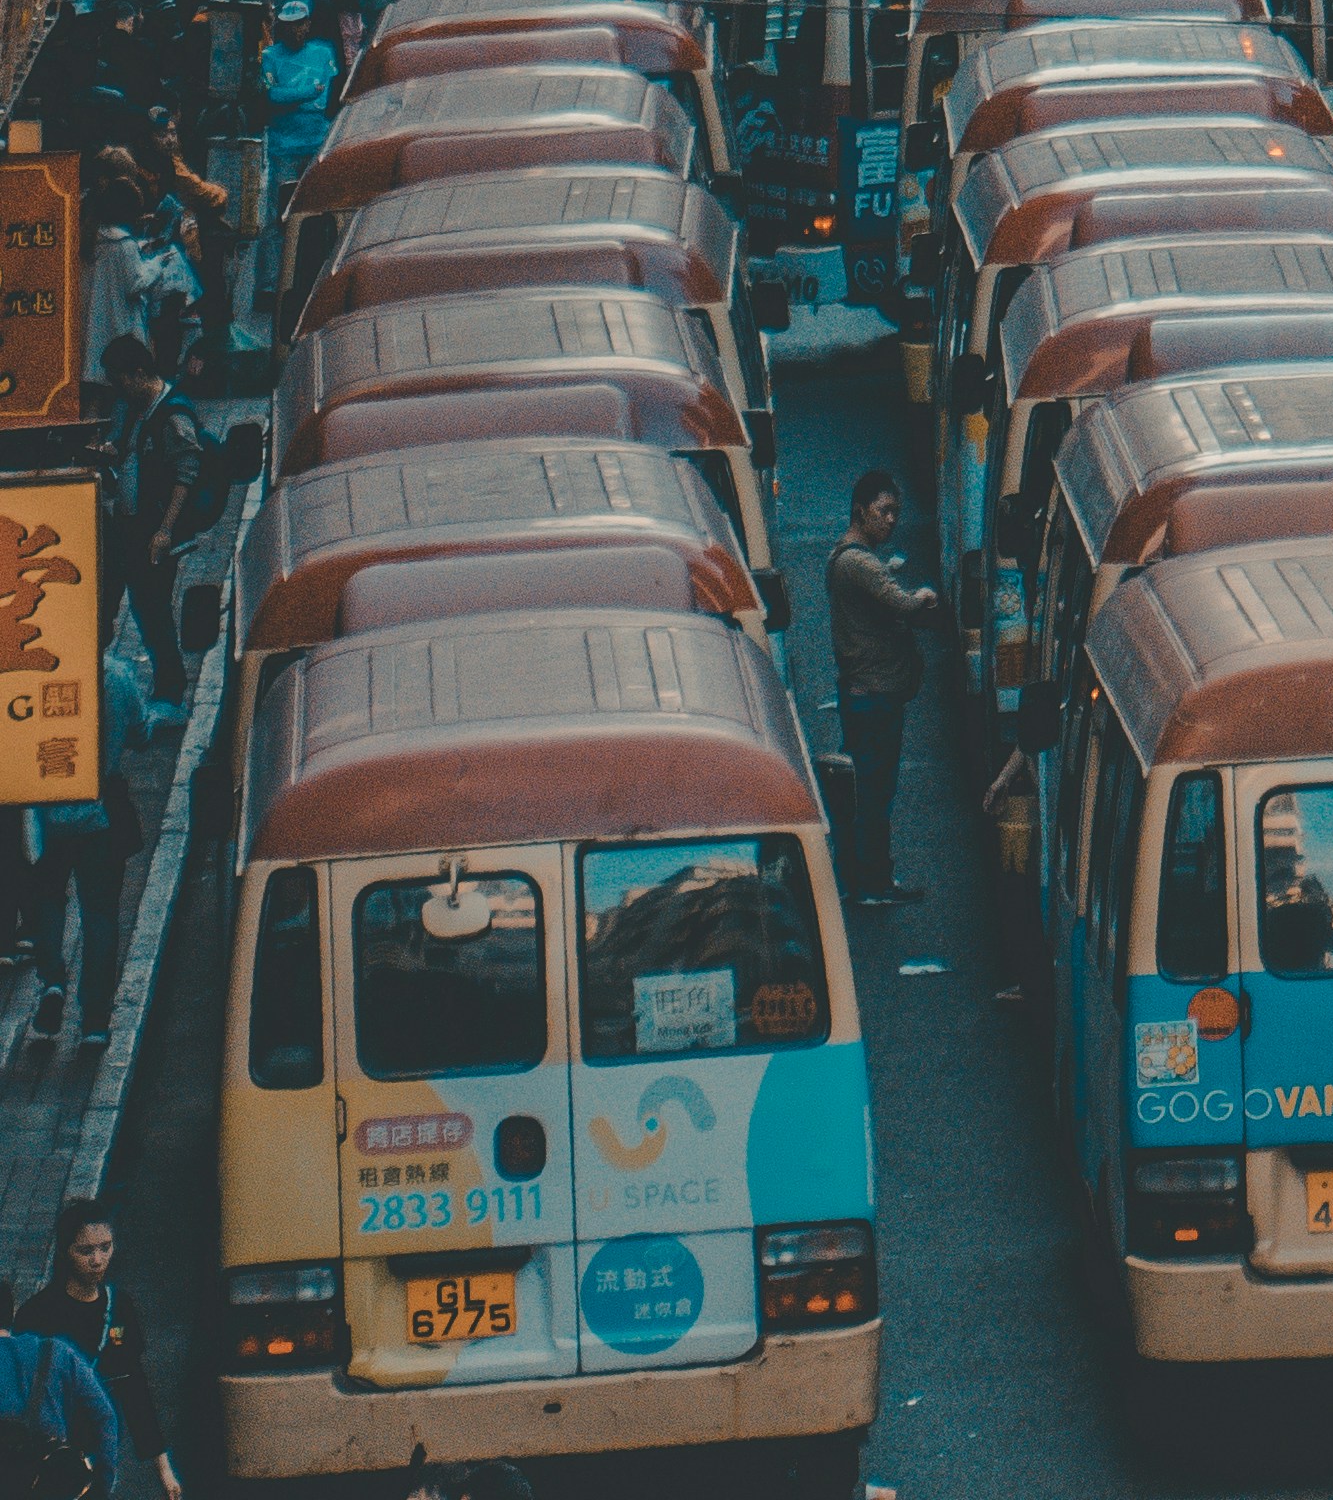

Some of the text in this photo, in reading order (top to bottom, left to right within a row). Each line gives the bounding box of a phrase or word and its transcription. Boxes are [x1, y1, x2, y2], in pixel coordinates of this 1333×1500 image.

[622, 1177, 720, 1208] SPACE
[358, 1184, 543, 1233] 2833 9111
[435, 1279, 479, 1309] GL
[594, 1263, 675, 1294] 流動式
[410, 1302, 513, 1339] 6775
